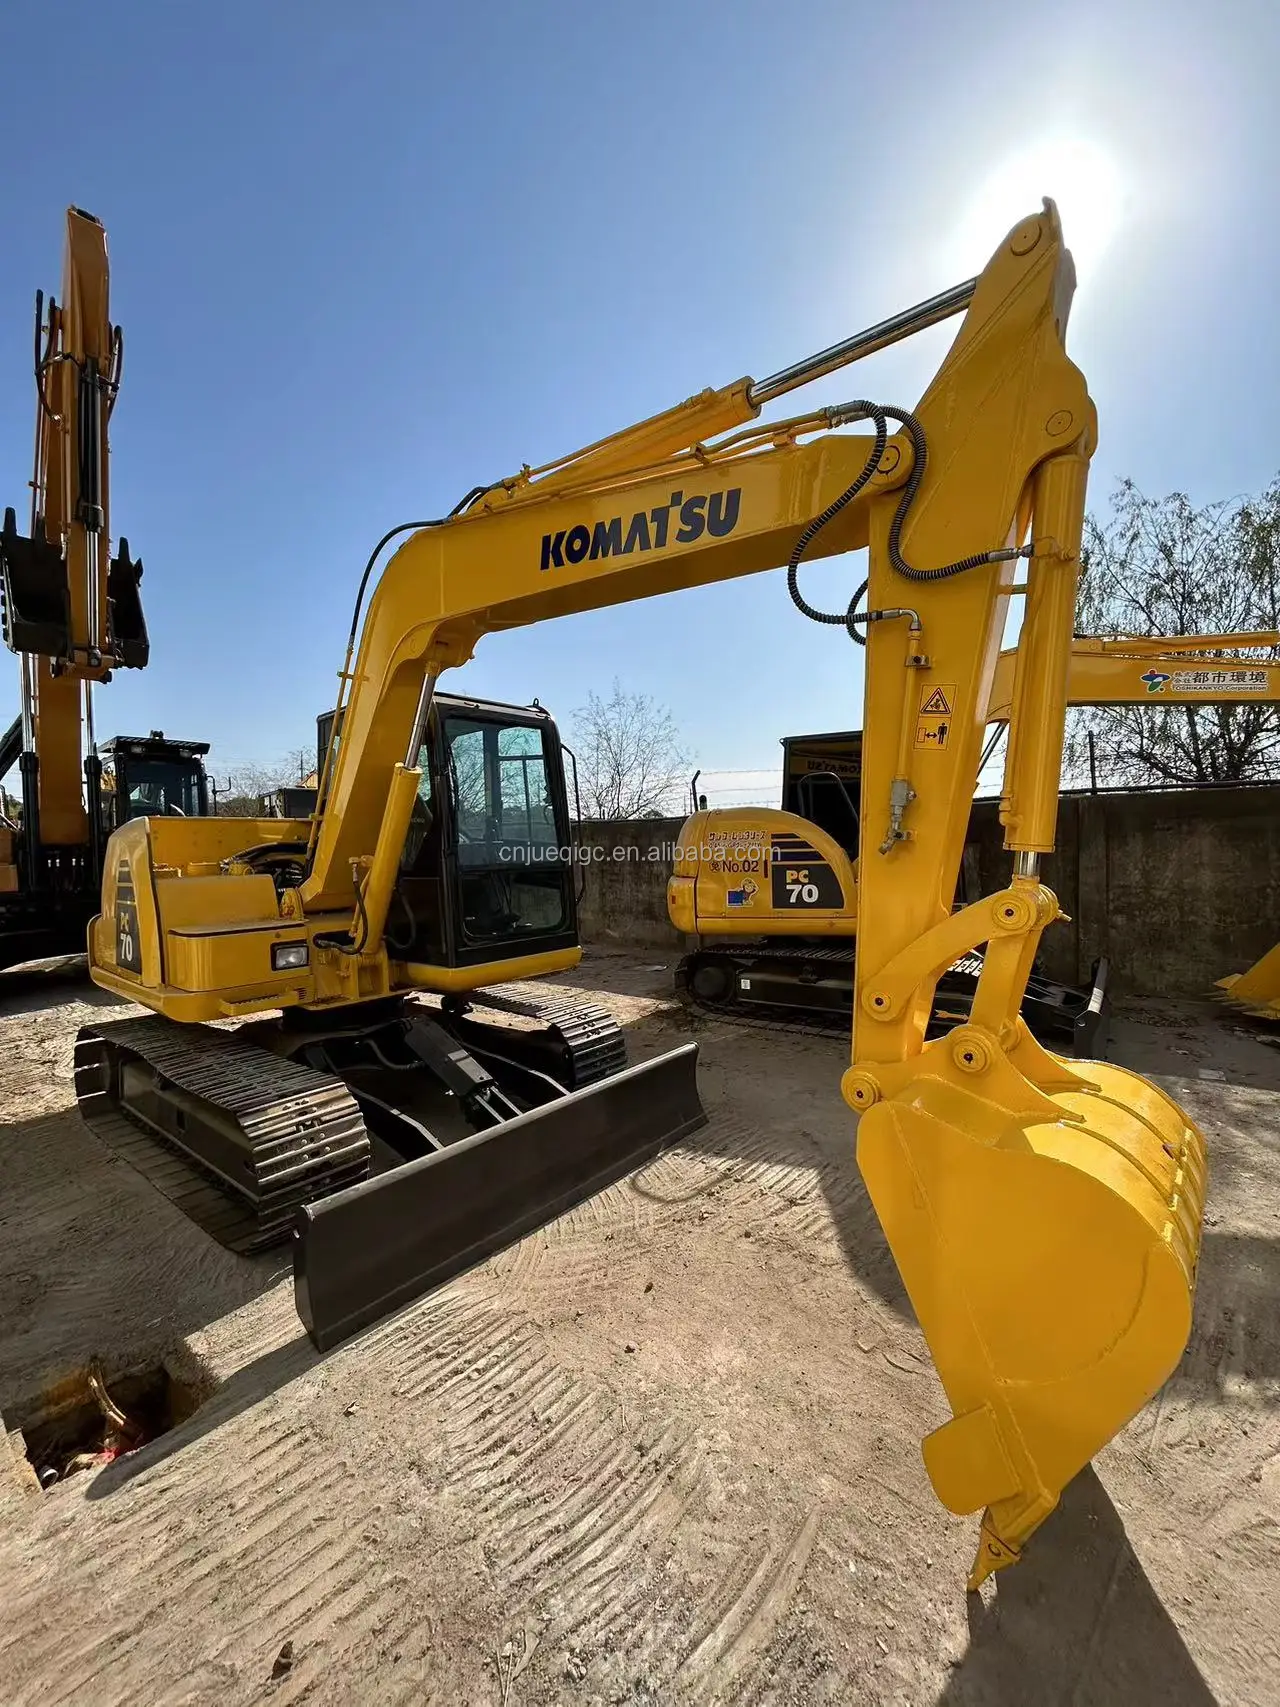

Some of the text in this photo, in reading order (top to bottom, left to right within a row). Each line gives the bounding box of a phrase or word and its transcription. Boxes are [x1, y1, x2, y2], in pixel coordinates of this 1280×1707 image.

[540, 488, 741, 570] KOMATSU
[1193, 671, 1267, 684] 都市環境
[722, 860, 759, 873] No.02
[786, 870, 809, 883] PC
[786, 884, 819, 903] 70
[120, 933, 133, 962] 70
